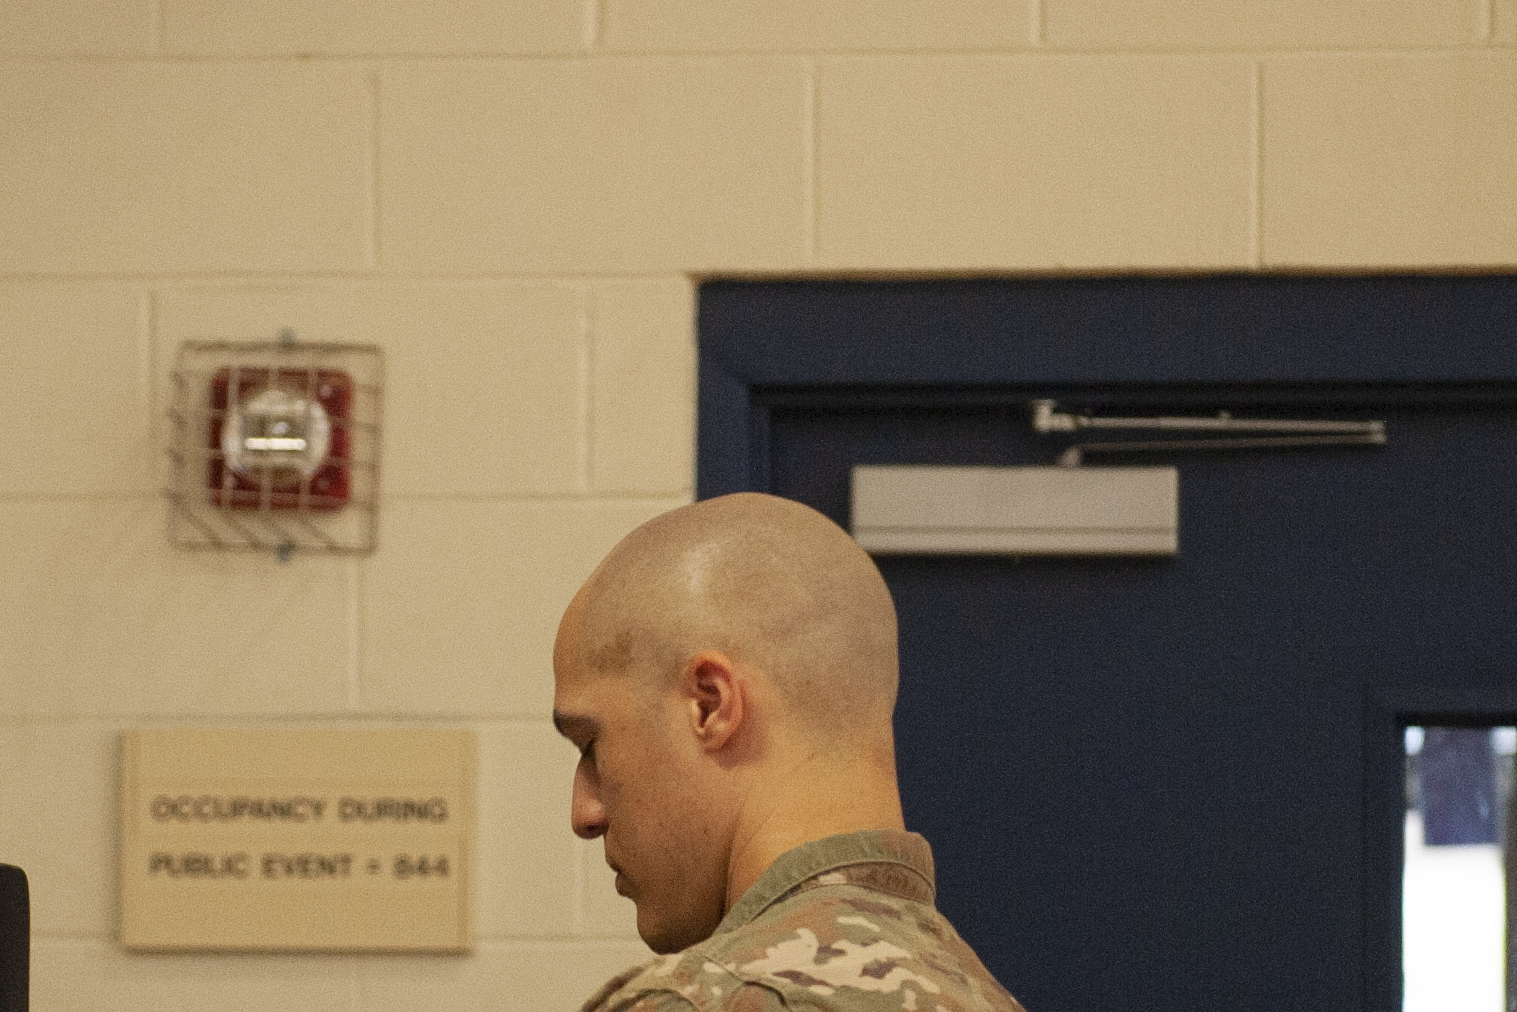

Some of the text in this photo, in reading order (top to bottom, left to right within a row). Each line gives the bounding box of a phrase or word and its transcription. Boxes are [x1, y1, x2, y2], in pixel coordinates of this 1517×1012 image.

[151, 795, 449, 824] OCCUPANCY DURING
[150, 853, 249, 880] PUBLIC
[261, 853, 354, 880] EVENT
